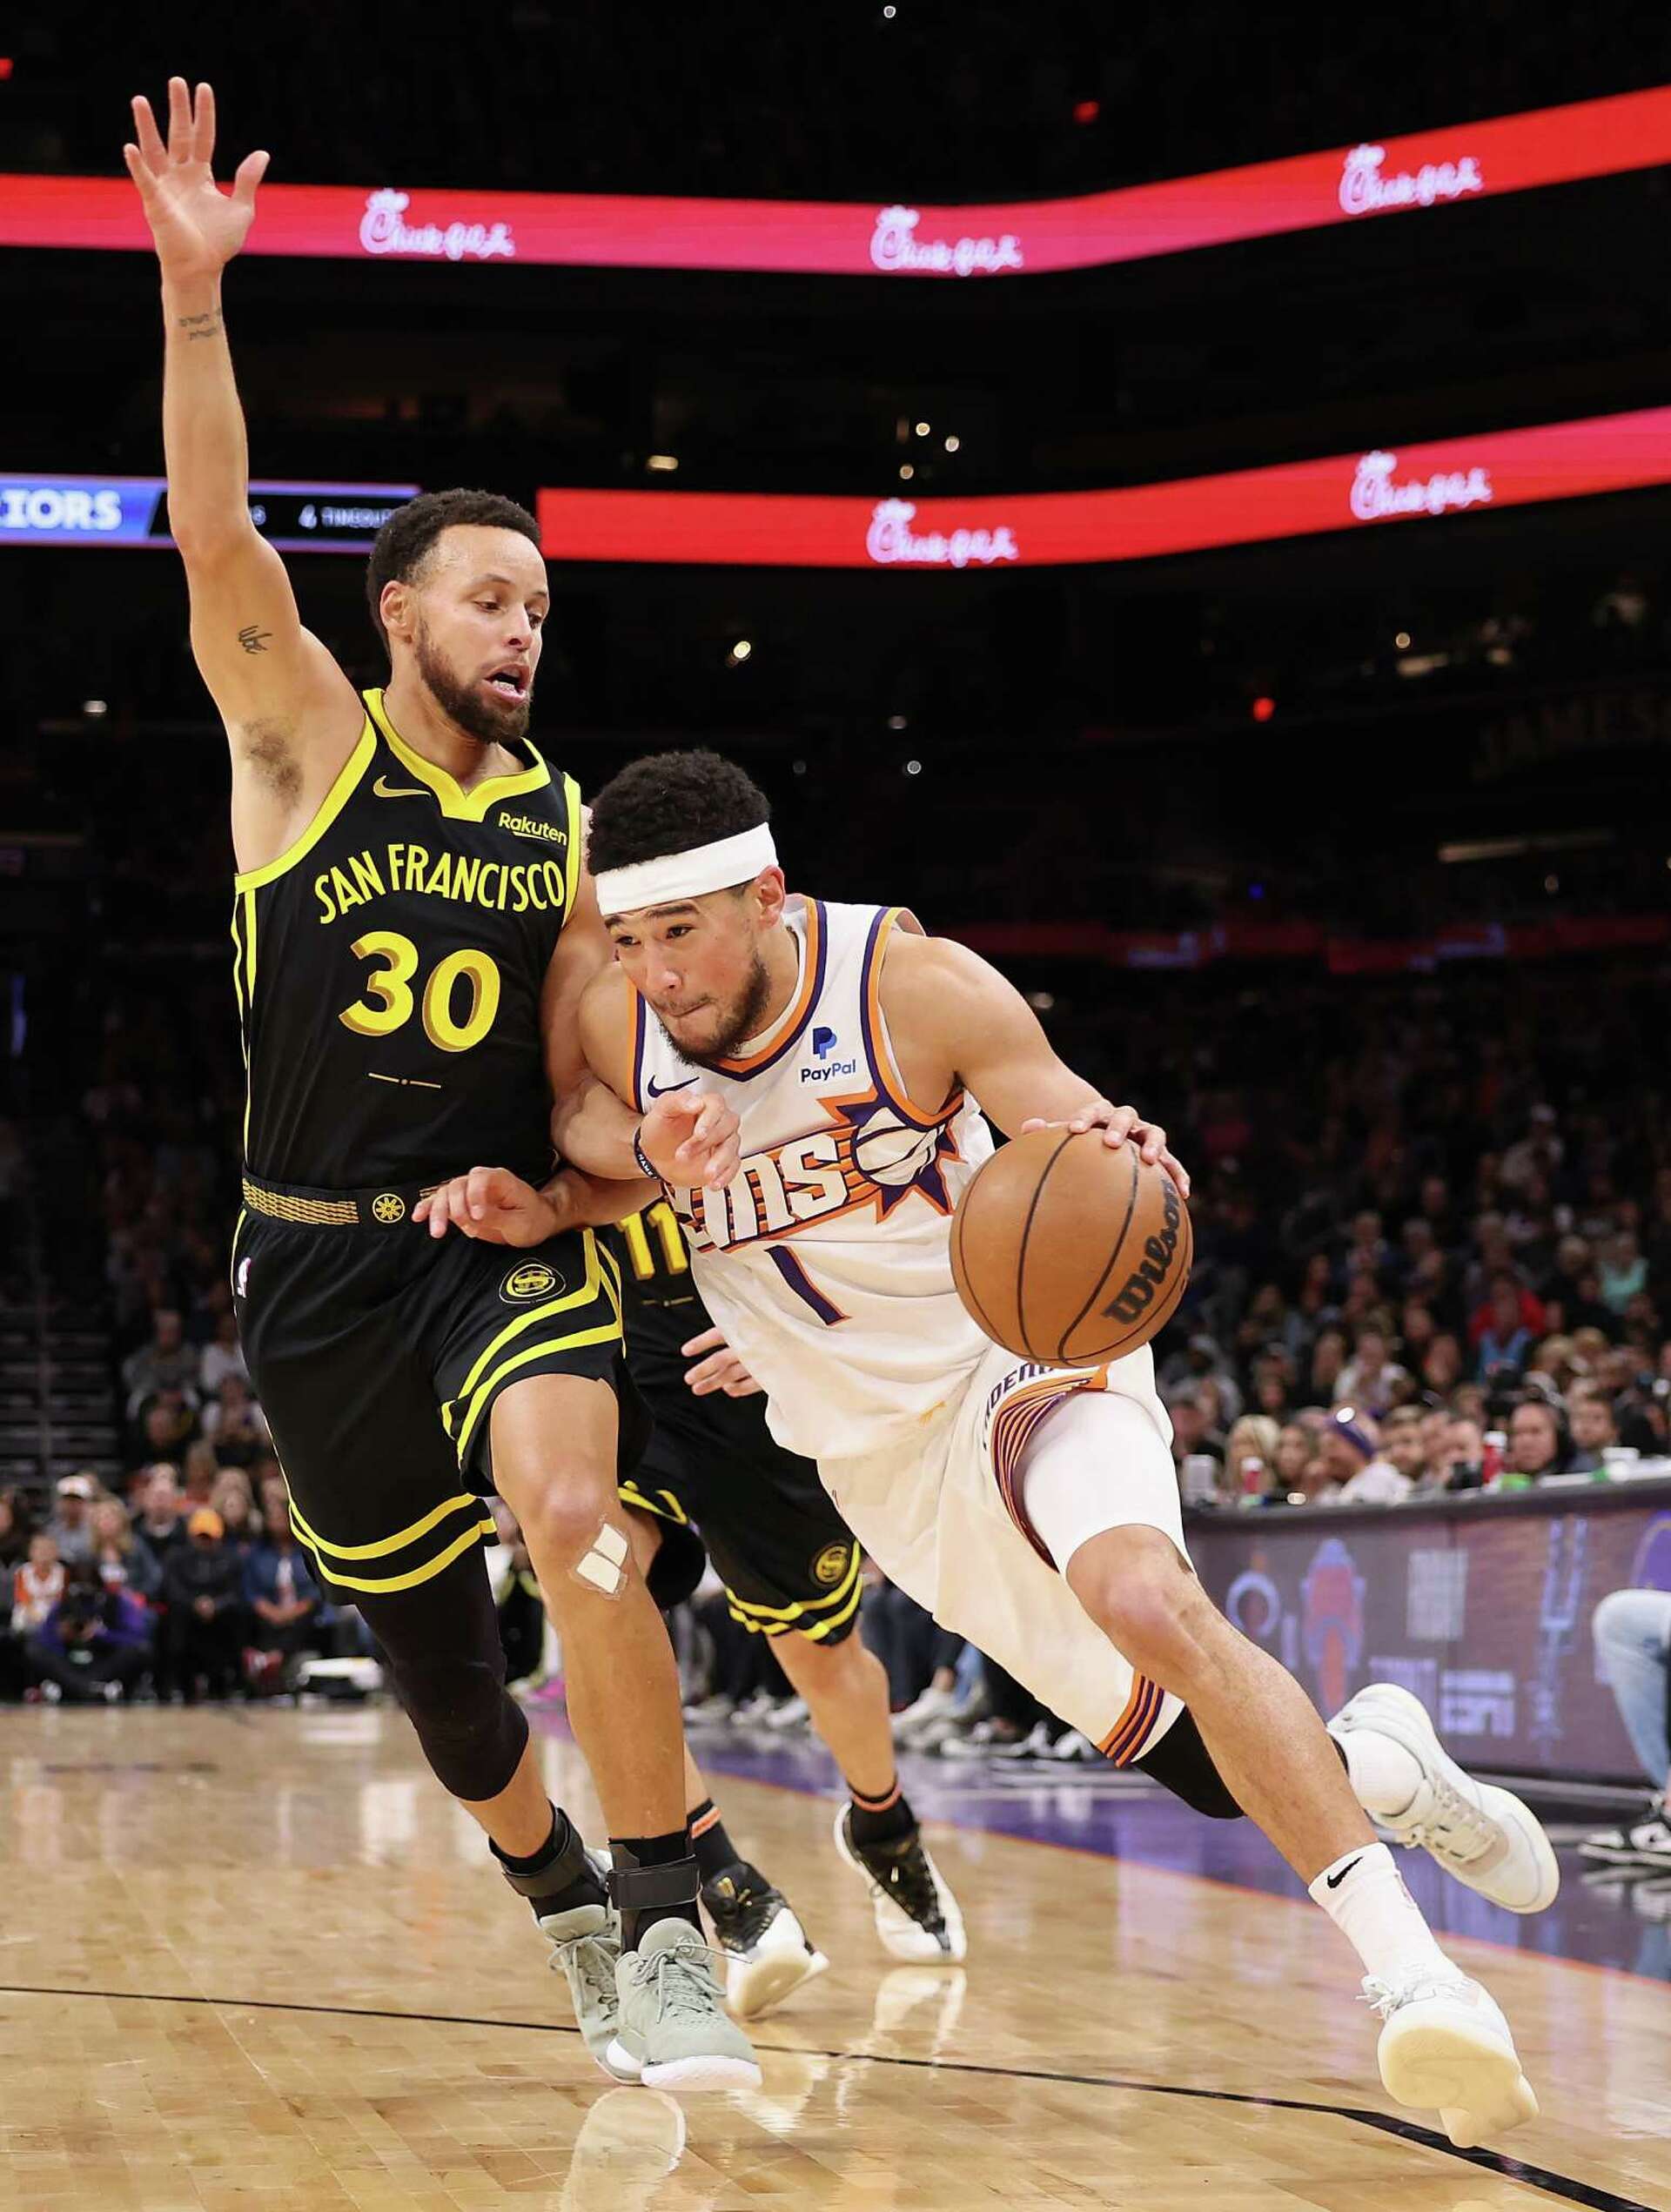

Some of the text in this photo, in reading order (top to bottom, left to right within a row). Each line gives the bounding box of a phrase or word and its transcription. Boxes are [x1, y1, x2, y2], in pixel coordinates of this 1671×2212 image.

[0, 489, 123, 531] IORS
[498, 812, 567, 846] Rakuten
[314, 843, 566, 924] SAN FRANCISCO
[339, 931, 500, 1052] 30
[801, 1058, 856, 1083] PayPal
[617, 1202, 689, 1281] 11
[1101, 1179, 1180, 1324] Wilson
